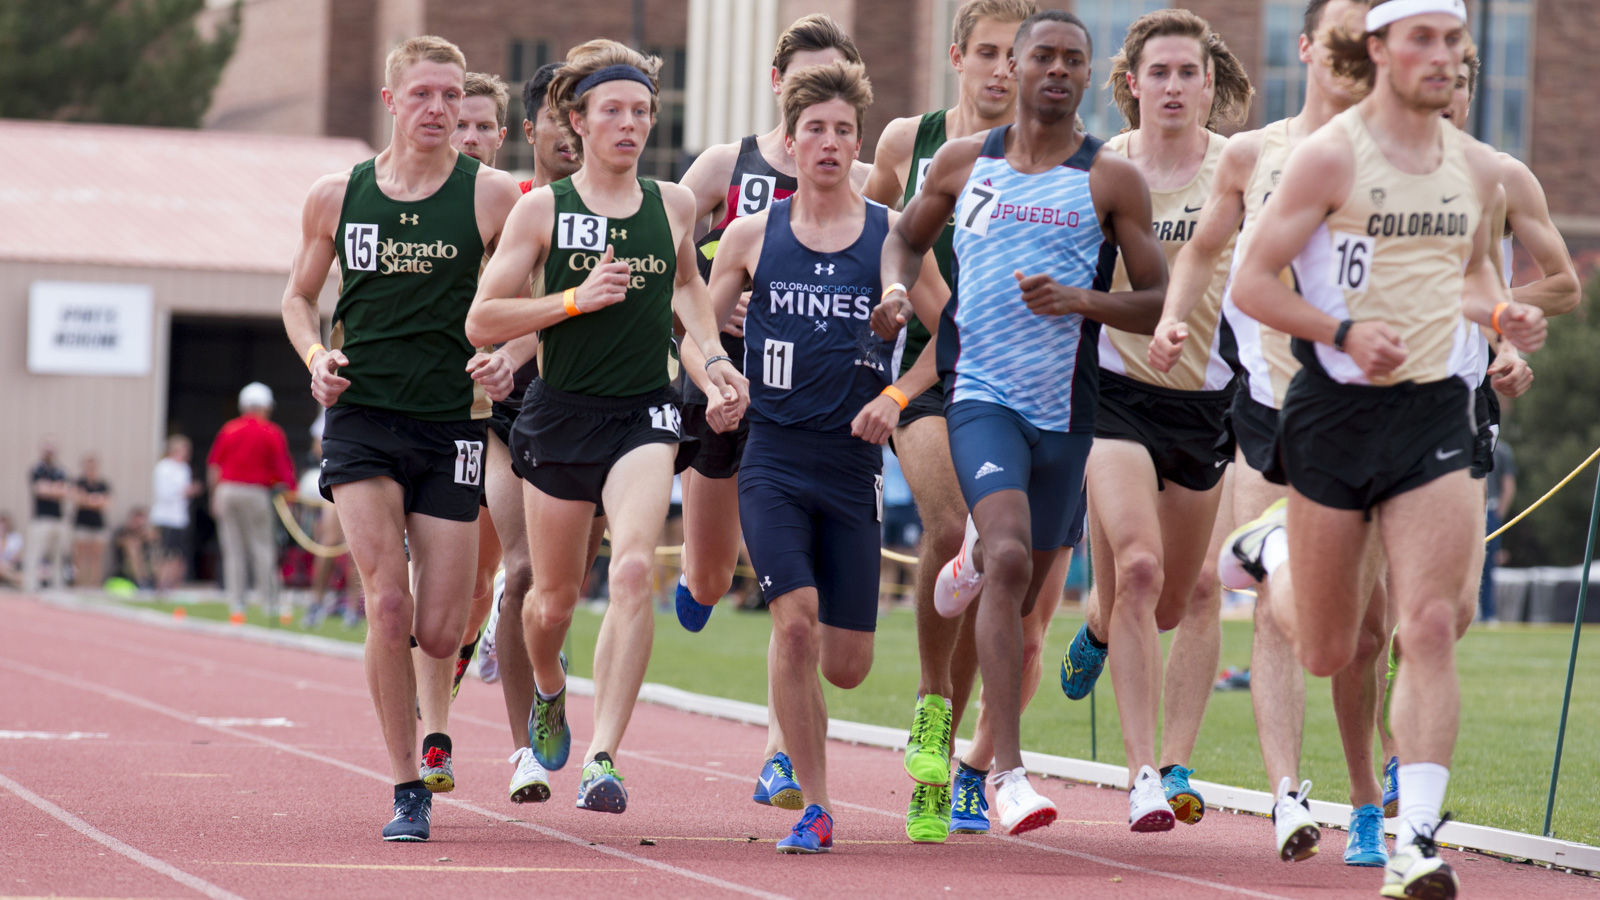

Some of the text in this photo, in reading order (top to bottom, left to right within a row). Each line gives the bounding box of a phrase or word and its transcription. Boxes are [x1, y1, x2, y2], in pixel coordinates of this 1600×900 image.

[743, 177, 770, 215] 9
[965, 186, 994, 228] 7
[562, 215, 600, 248] 13
[1366, 213, 1468, 237] COLORADO
[347, 226, 373, 269] 15
[376, 238, 459, 259] olorado
[380, 253, 433, 275] State
[1337, 239, 1367, 288] 16
[769, 290, 871, 320] MINES
[766, 343, 786, 386] 11
[460, 443, 480, 483] 15
